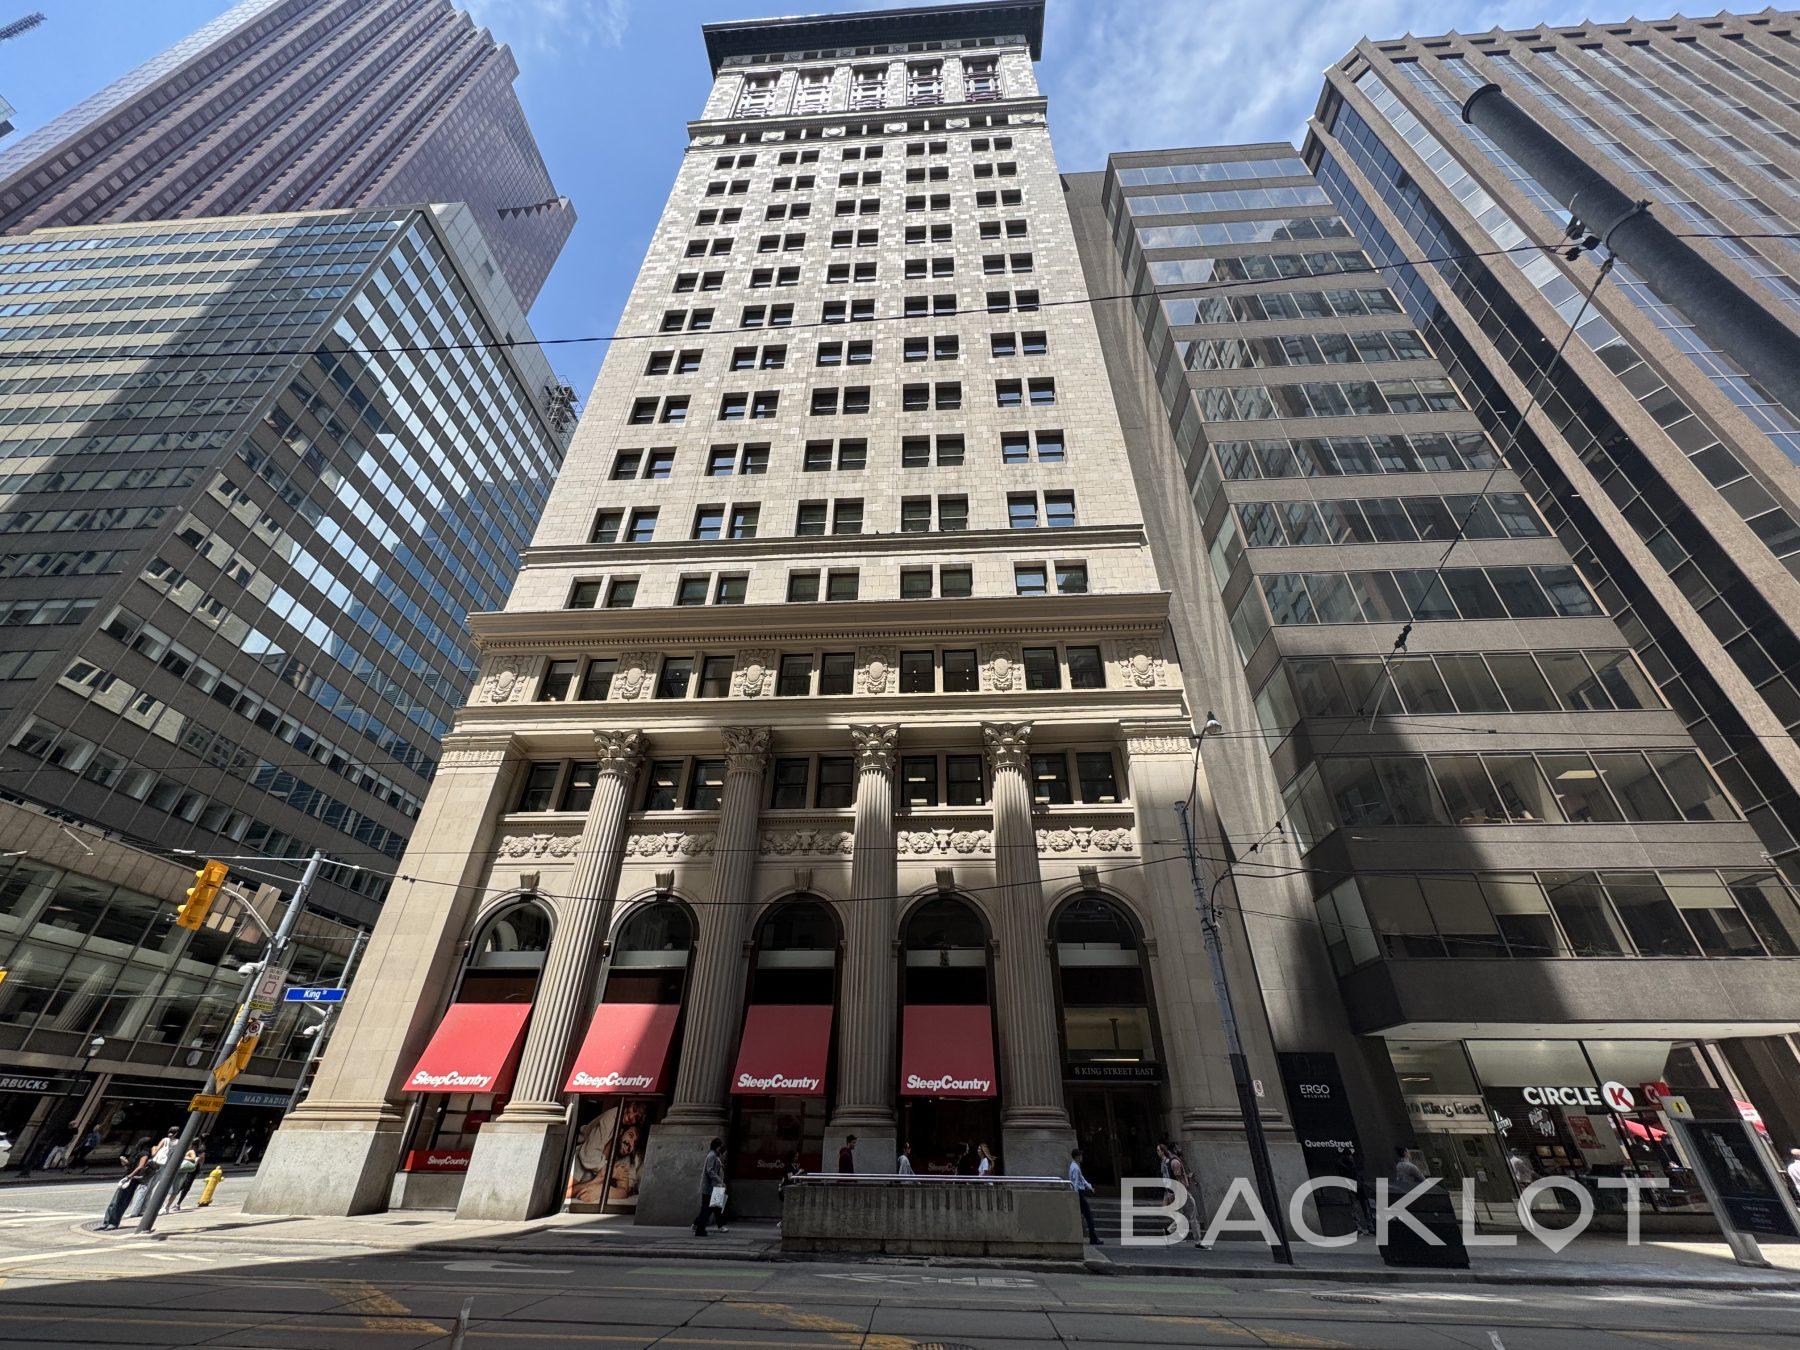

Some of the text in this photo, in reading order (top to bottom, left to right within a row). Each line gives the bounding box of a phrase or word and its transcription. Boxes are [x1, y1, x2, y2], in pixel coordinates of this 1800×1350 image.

[303, 989, 321, 1000] King
[1074, 1066, 1155, 1076] 8 KING STREET EAST
[411, 1070, 492, 1088] SleepCountry
[572, 1071, 654, 1089] SleepCountry
[737, 1073, 820, 1090] SleepCountry
[906, 1074, 991, 1091] SleepCountry
[1300, 1084, 1330, 1094] ERGO
[243, 1095, 261, 1104] MAD
[1522, 1086, 1634, 1109] CIRCLE K
[1420, 1102, 1454, 1117] King
[1453, 1102, 1484, 1114] East
[1305, 1139, 1354, 1148] QueenStreet
[427, 1155, 470, 1167] SleepCountry
